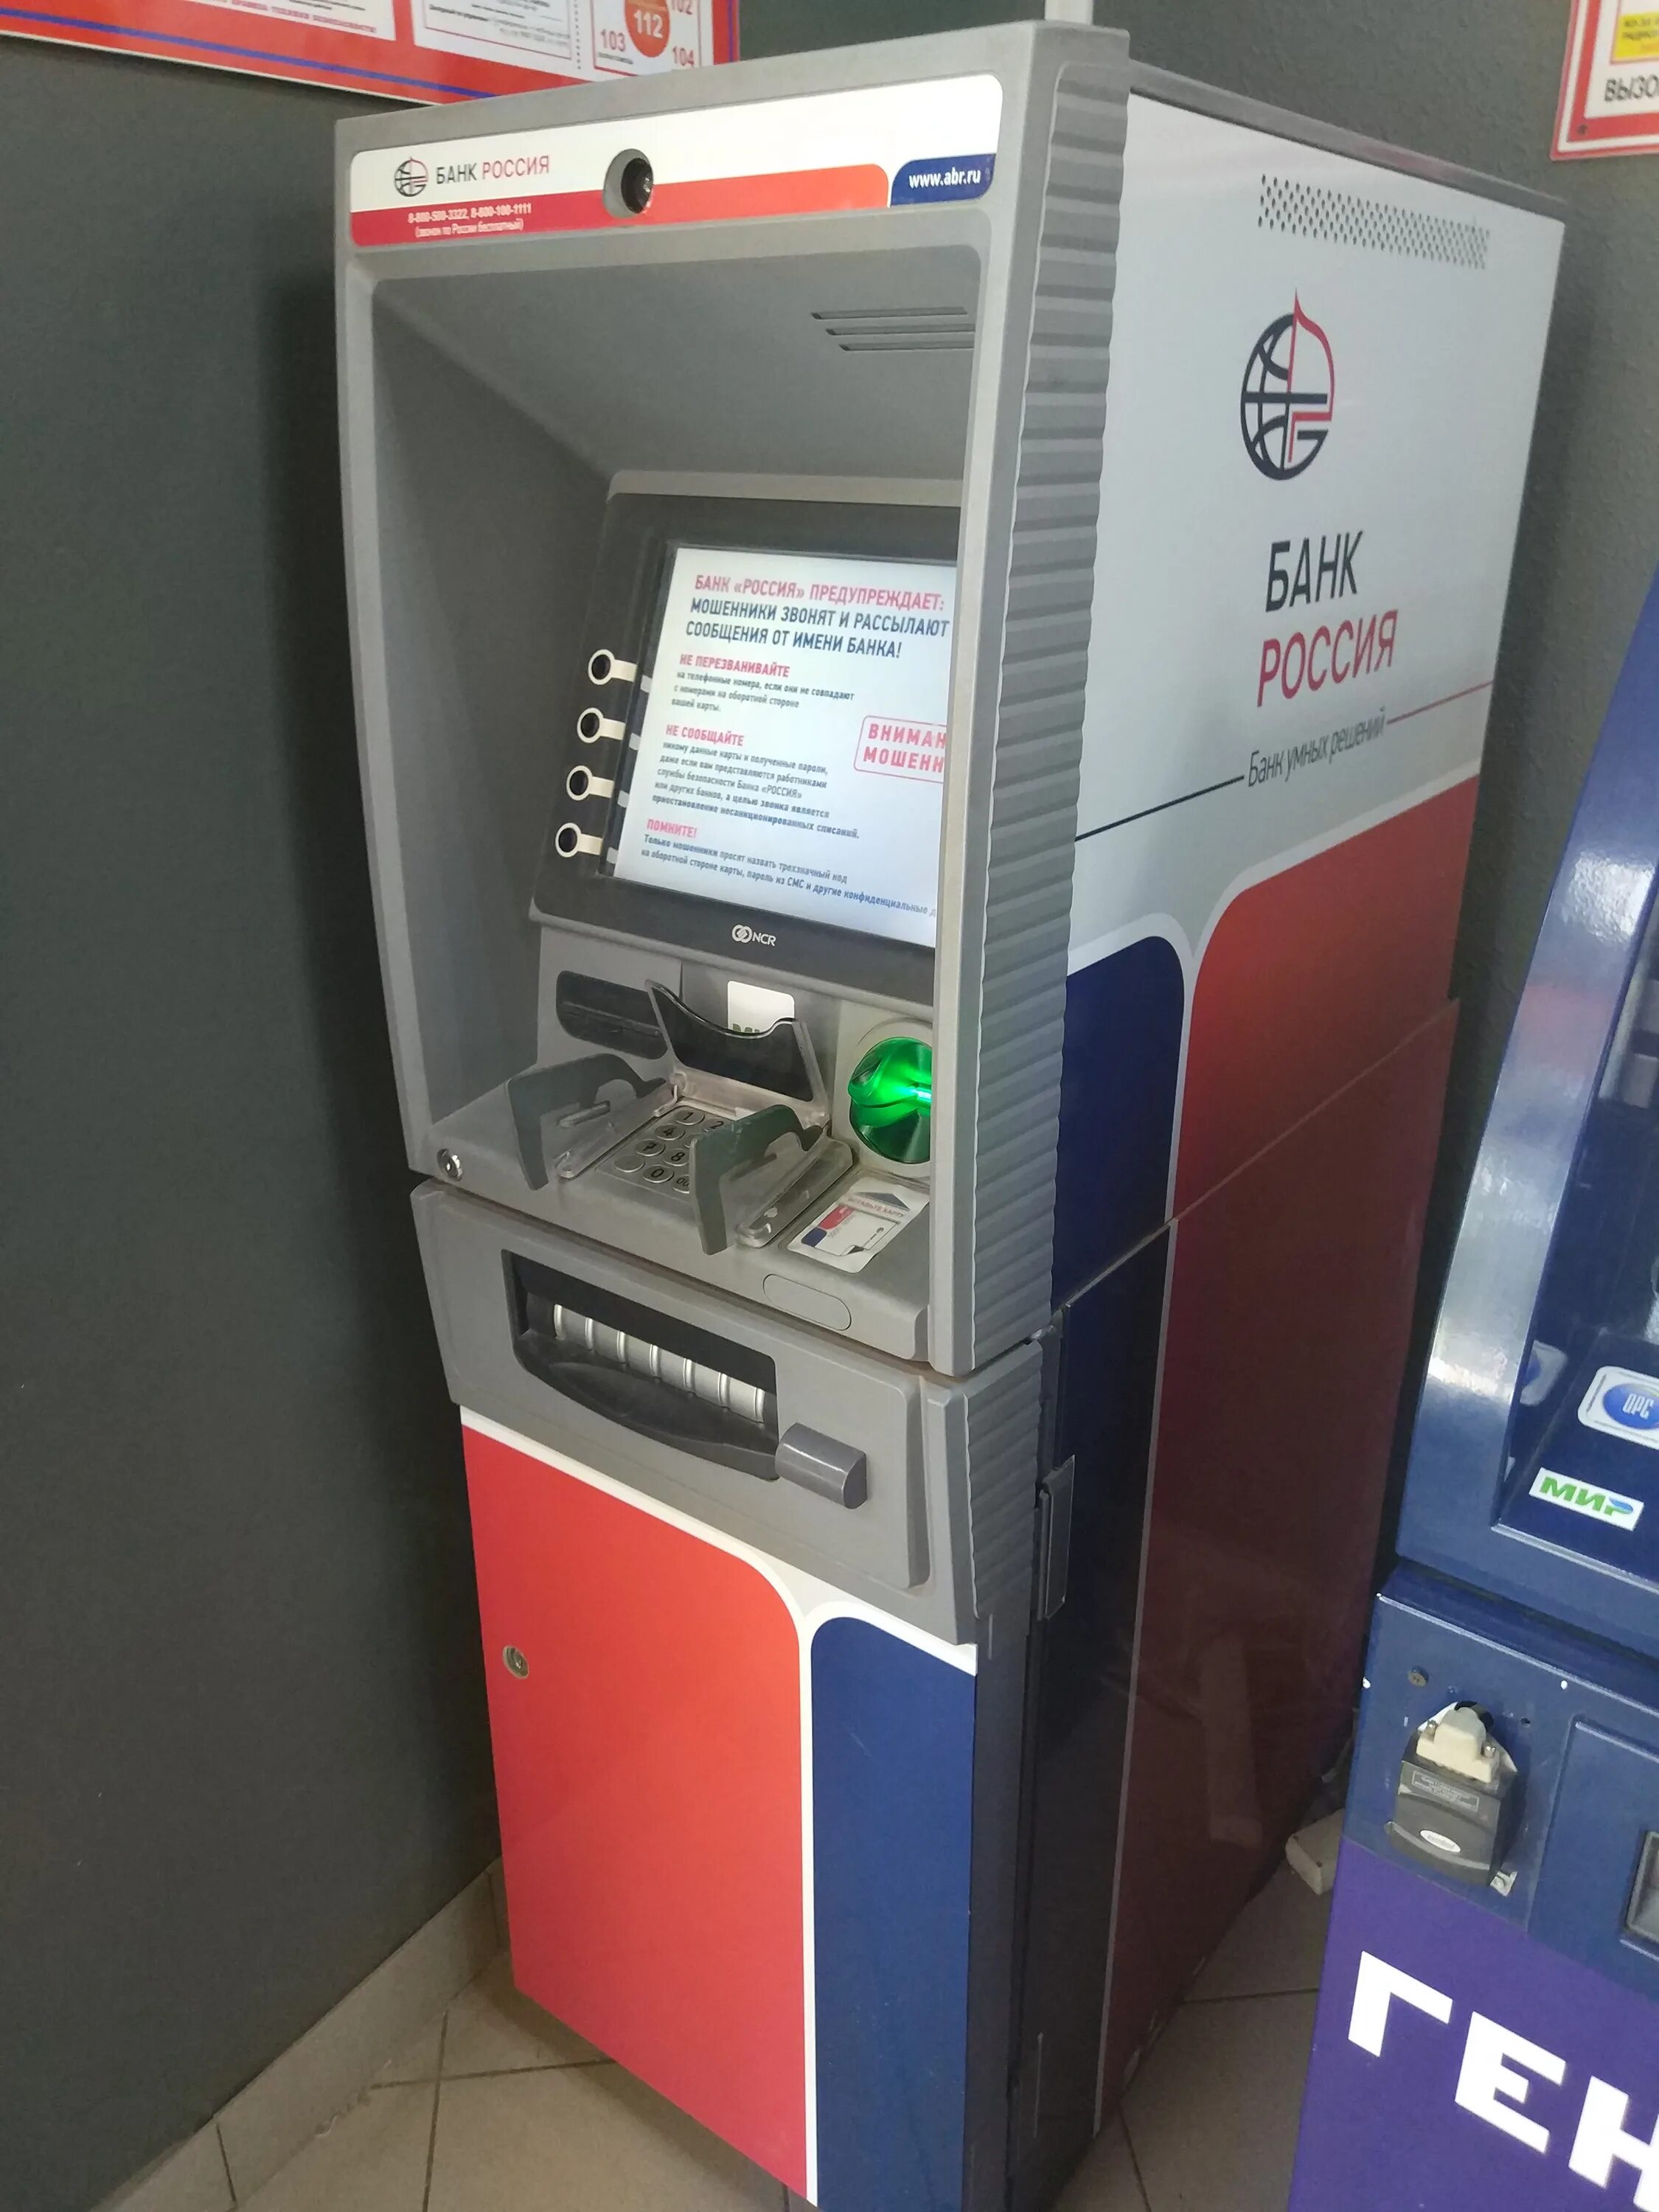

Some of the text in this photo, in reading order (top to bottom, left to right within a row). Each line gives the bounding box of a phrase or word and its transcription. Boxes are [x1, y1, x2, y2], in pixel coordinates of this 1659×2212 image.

[633, 9, 664, 39] 112
[600, 28, 626, 52] 103
[672, 45, 695, 67] 104
[436, 155, 550, 184] БАНК РОССИЯ
[908, 166, 981, 189] www.abr.ru
[1265, 529, 1363, 613] БАНК
[695, 574, 945, 611] БАНК «РОССИЯ» ПРЕДУПРЕЖДАЕТ:
[690, 597, 950, 637] МОШЕННИКИ ЗВОНЯТ И РАССЫЛАЮТ
[686, 620, 902, 658] СООБЩЕНИЯ ОТ ИМЕНИ БАНКА!
[679, 653, 790, 678] НЕ ПЕРЕЗВАНИВАЙТЕ
[1256, 608, 1398, 708] РОССИЯ
[677, 671, 855, 700] на телефонные номера, если они не совпадают
[680, 686, 716, 697] номерами
[728, 691, 768, 703] оборотной
[769, 697, 799, 709] стороне
[671, 698, 695, 707] вашей
[666, 724, 745, 746] НЕ СООБЩАЙТЕ
[868, 723, 947, 749] ВНИМАН
[1248, 706, 1386, 787] Банк умных решений
[660, 754, 679, 764] даже
[681, 759, 698, 767] если
[714, 764, 775, 780] представляются
[776, 773, 827, 788] работниками
[663, 742, 689, 754] никому
[689, 745, 717, 757] данные
[720, 751, 742, 761] карты
[751, 755, 796, 768] полученные
[798, 762, 828, 776] пароли,
[863, 745, 944, 773] МОШЕНН
[657, 768, 802, 799] службы безопасности Банка «РОССИЯ»
[655, 782, 668, 790] или
[669, 784, 695, 795] других
[732, 795, 759, 806] целью
[760, 800, 789, 811] звонка
[791, 805, 830, 818] является
[646, 818, 698, 838] ПОМНИТЕ!
[816, 824, 860, 839] списаний.
[641, 849, 650, 857] на
[651, 850, 688, 864] оборотной
[689, 858, 718, 871] стороне
[719, 865, 745, 878] карты,
[747, 870, 773, 883] пароль
[776, 876, 785, 885] из
[787, 877, 804, 889] СМС
[806, 882, 812, 891] и
[813, 884, 842, 897] другие
[644, 833, 848, 885] Только мошенники просят назвать трехзначный код
[752, 931, 776, 947] NCR
[709, 1120, 725, 1130] 2
[670, 1152, 686, 1162] 8
[650, 1168, 664, 1178] 0
[1539, 1475, 1634, 1517] МИР
[1348, 1950, 1659, 2212] ГЕН
